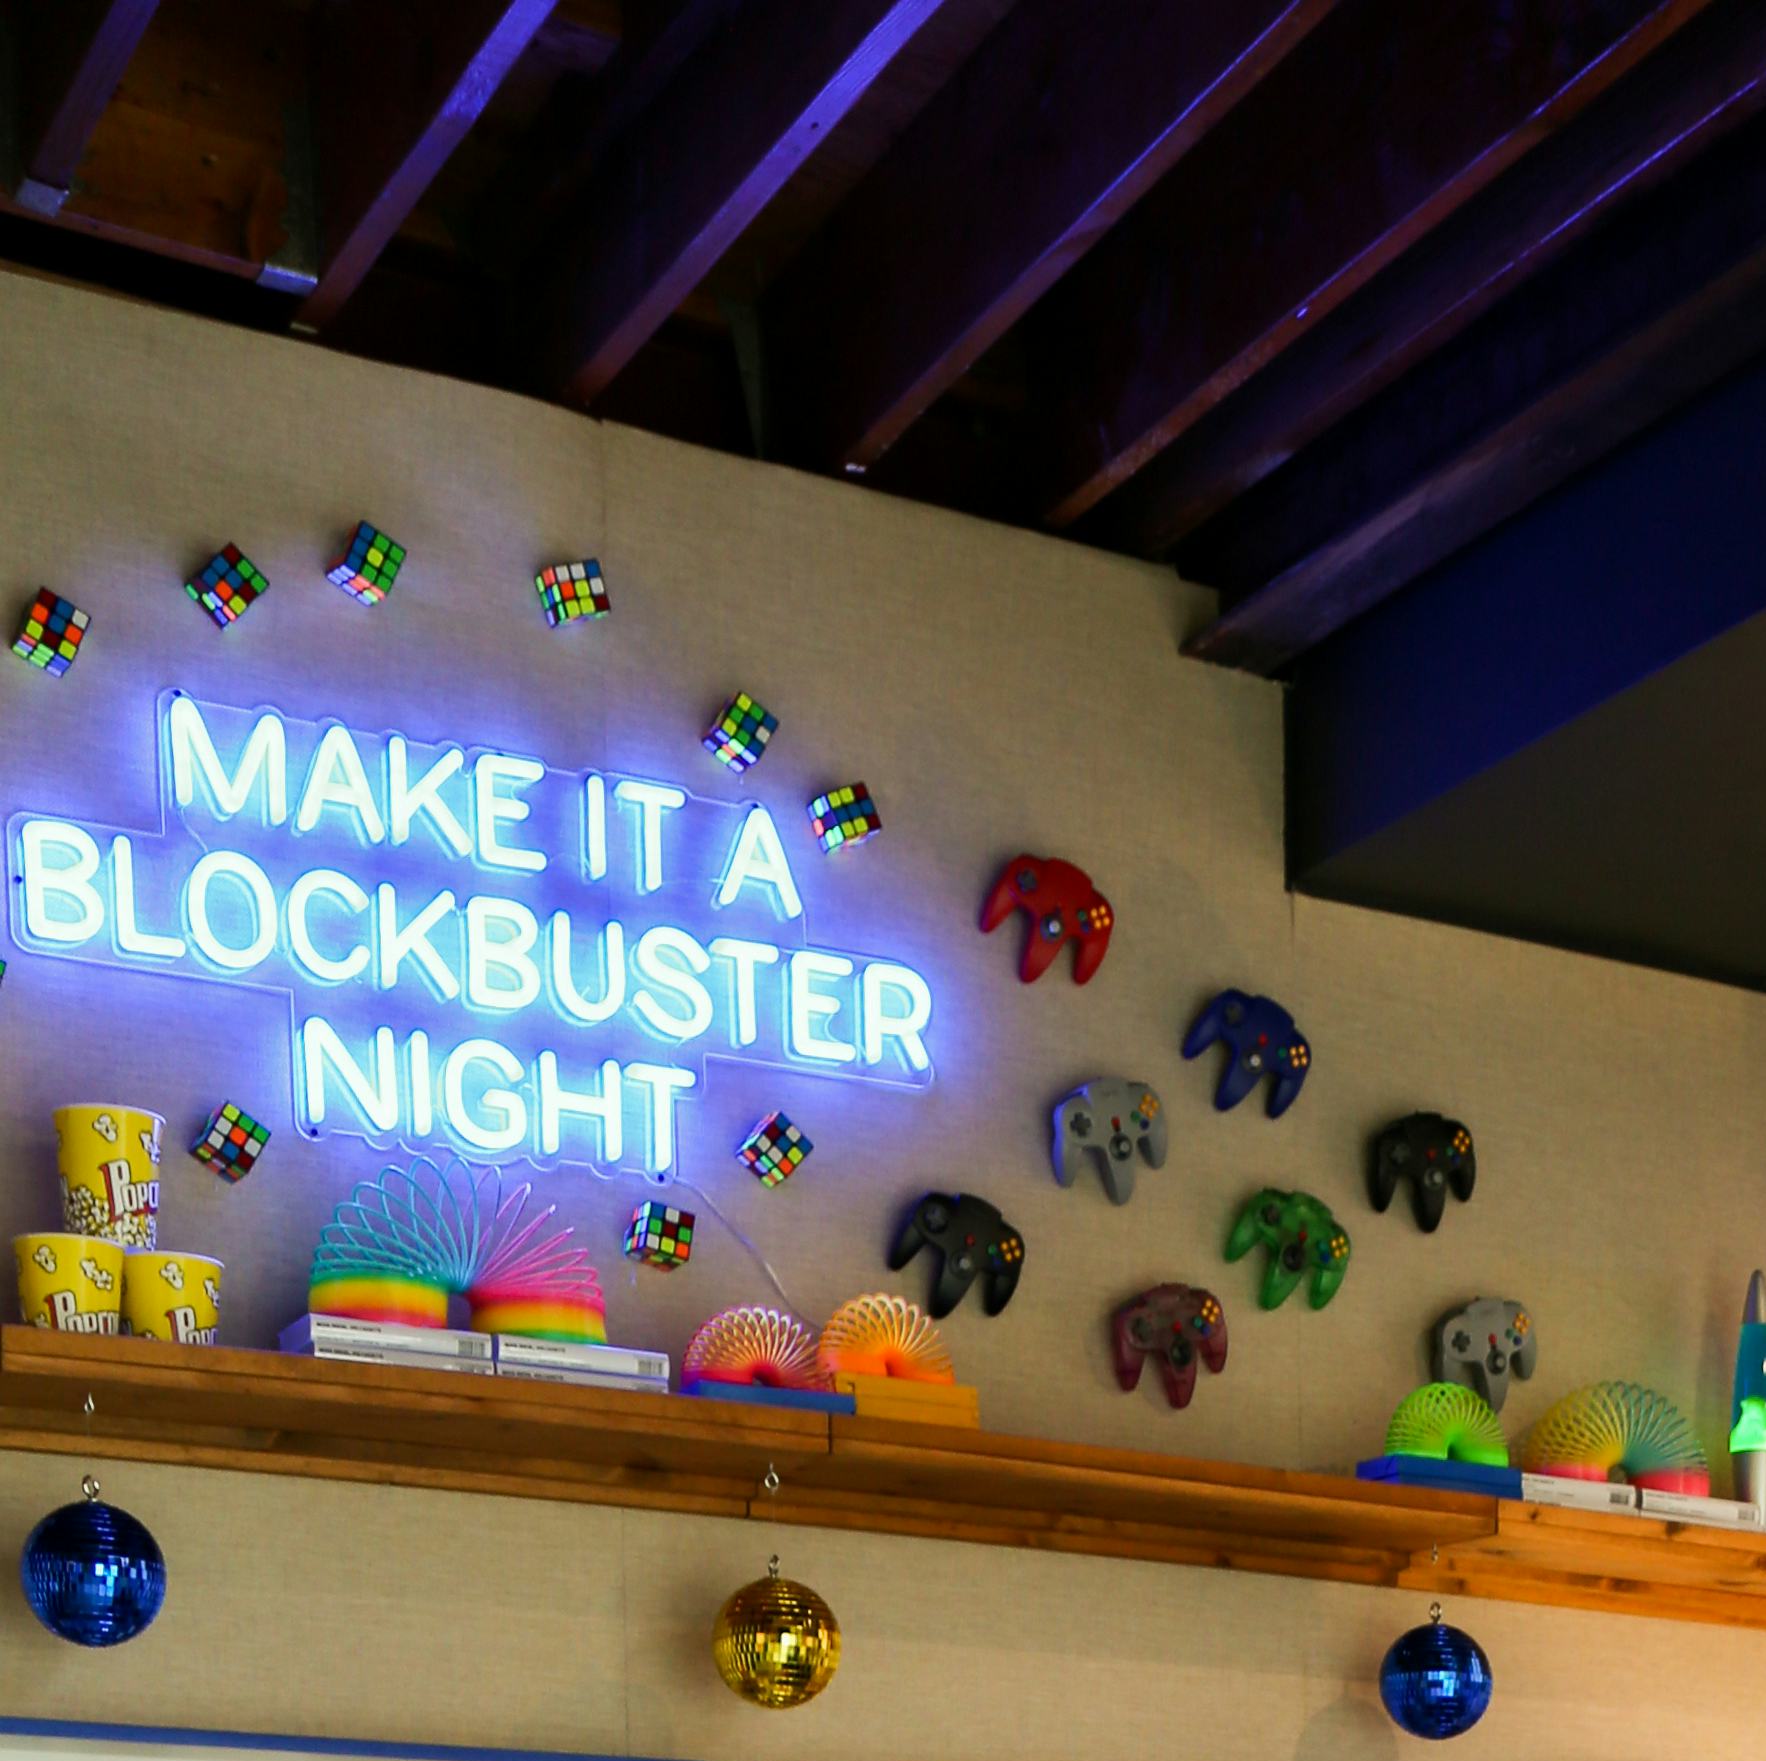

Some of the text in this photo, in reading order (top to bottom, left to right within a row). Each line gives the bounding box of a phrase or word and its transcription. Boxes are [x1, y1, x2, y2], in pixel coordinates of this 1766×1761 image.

[170, 695, 803, 920] MAKE IT A
[21, 818, 934, 1074] BLOCKBUSTER
[300, 1015, 696, 1172] NIGHT
